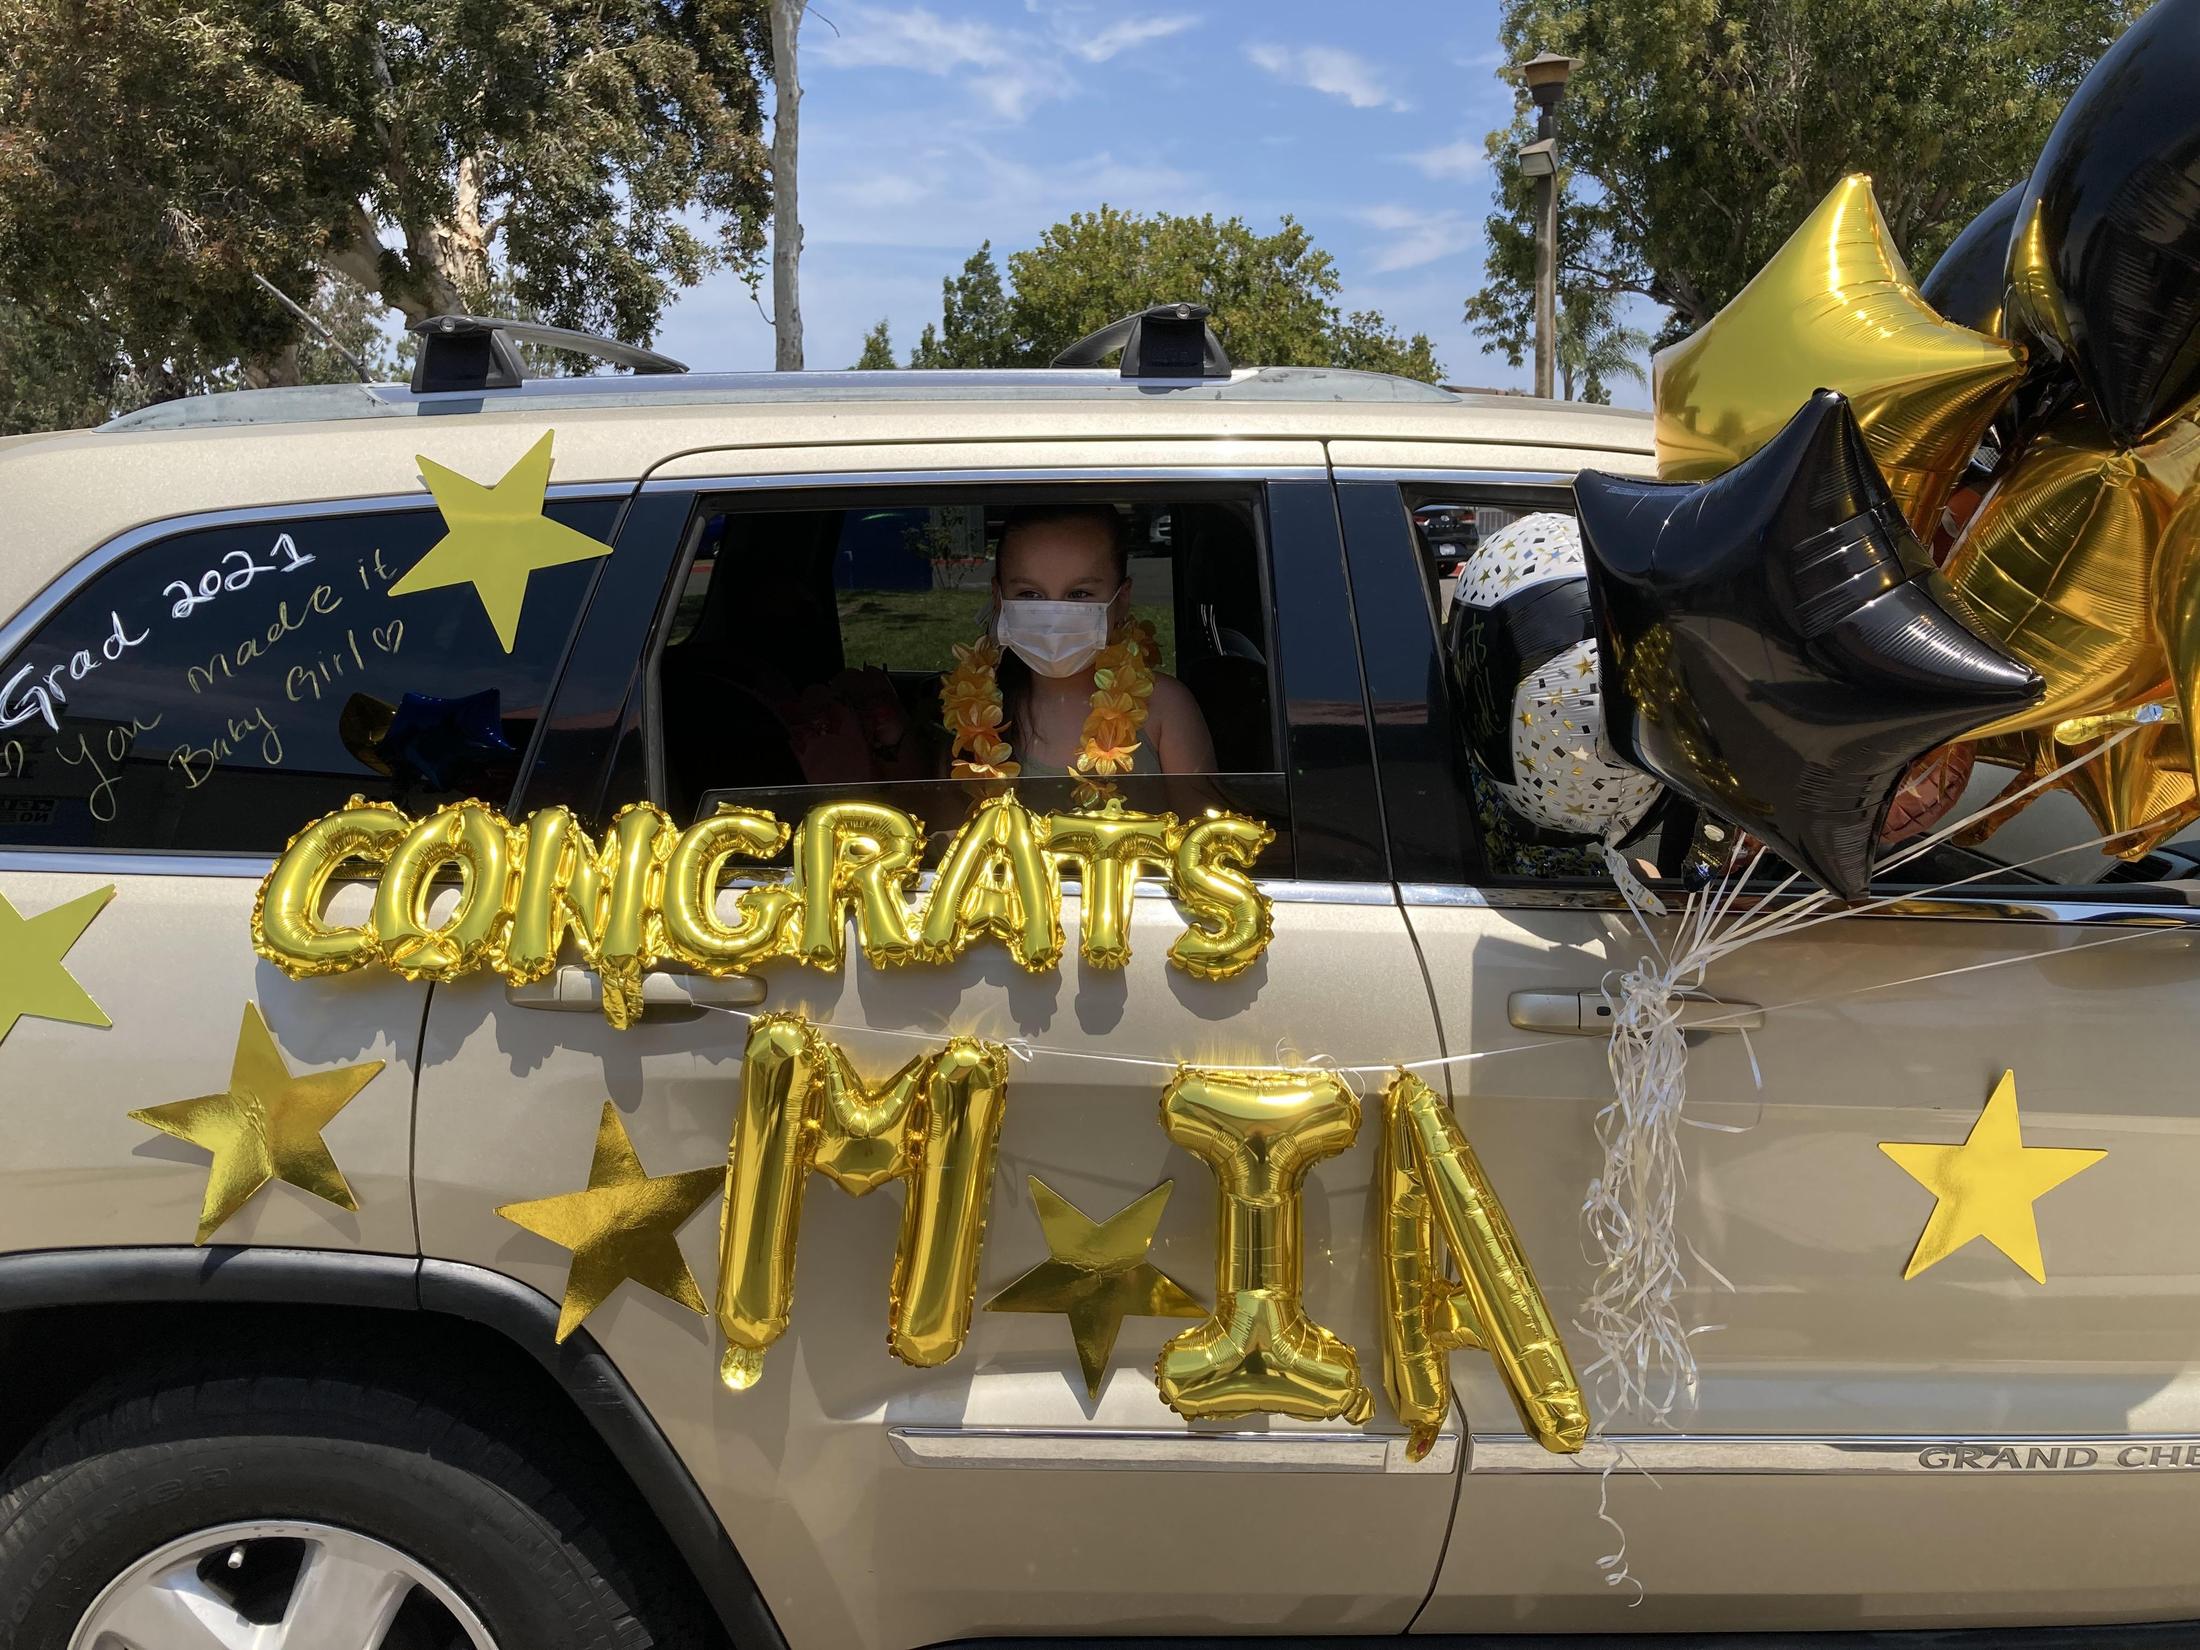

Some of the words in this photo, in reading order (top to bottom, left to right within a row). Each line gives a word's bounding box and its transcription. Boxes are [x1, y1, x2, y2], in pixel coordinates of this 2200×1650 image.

[0, 611, 150, 733] Grad
[162, 533, 317, 619] 2021
[358, 548, 398, 590] it
[168, 707, 283, 789] Baby
[286, 629, 365, 701] Girl
[252, 789, 1276, 1029] CONGRATS
[716, 1011, 1589, 1461] MIA
[1918, 1446, 2098, 1469] GRAND
